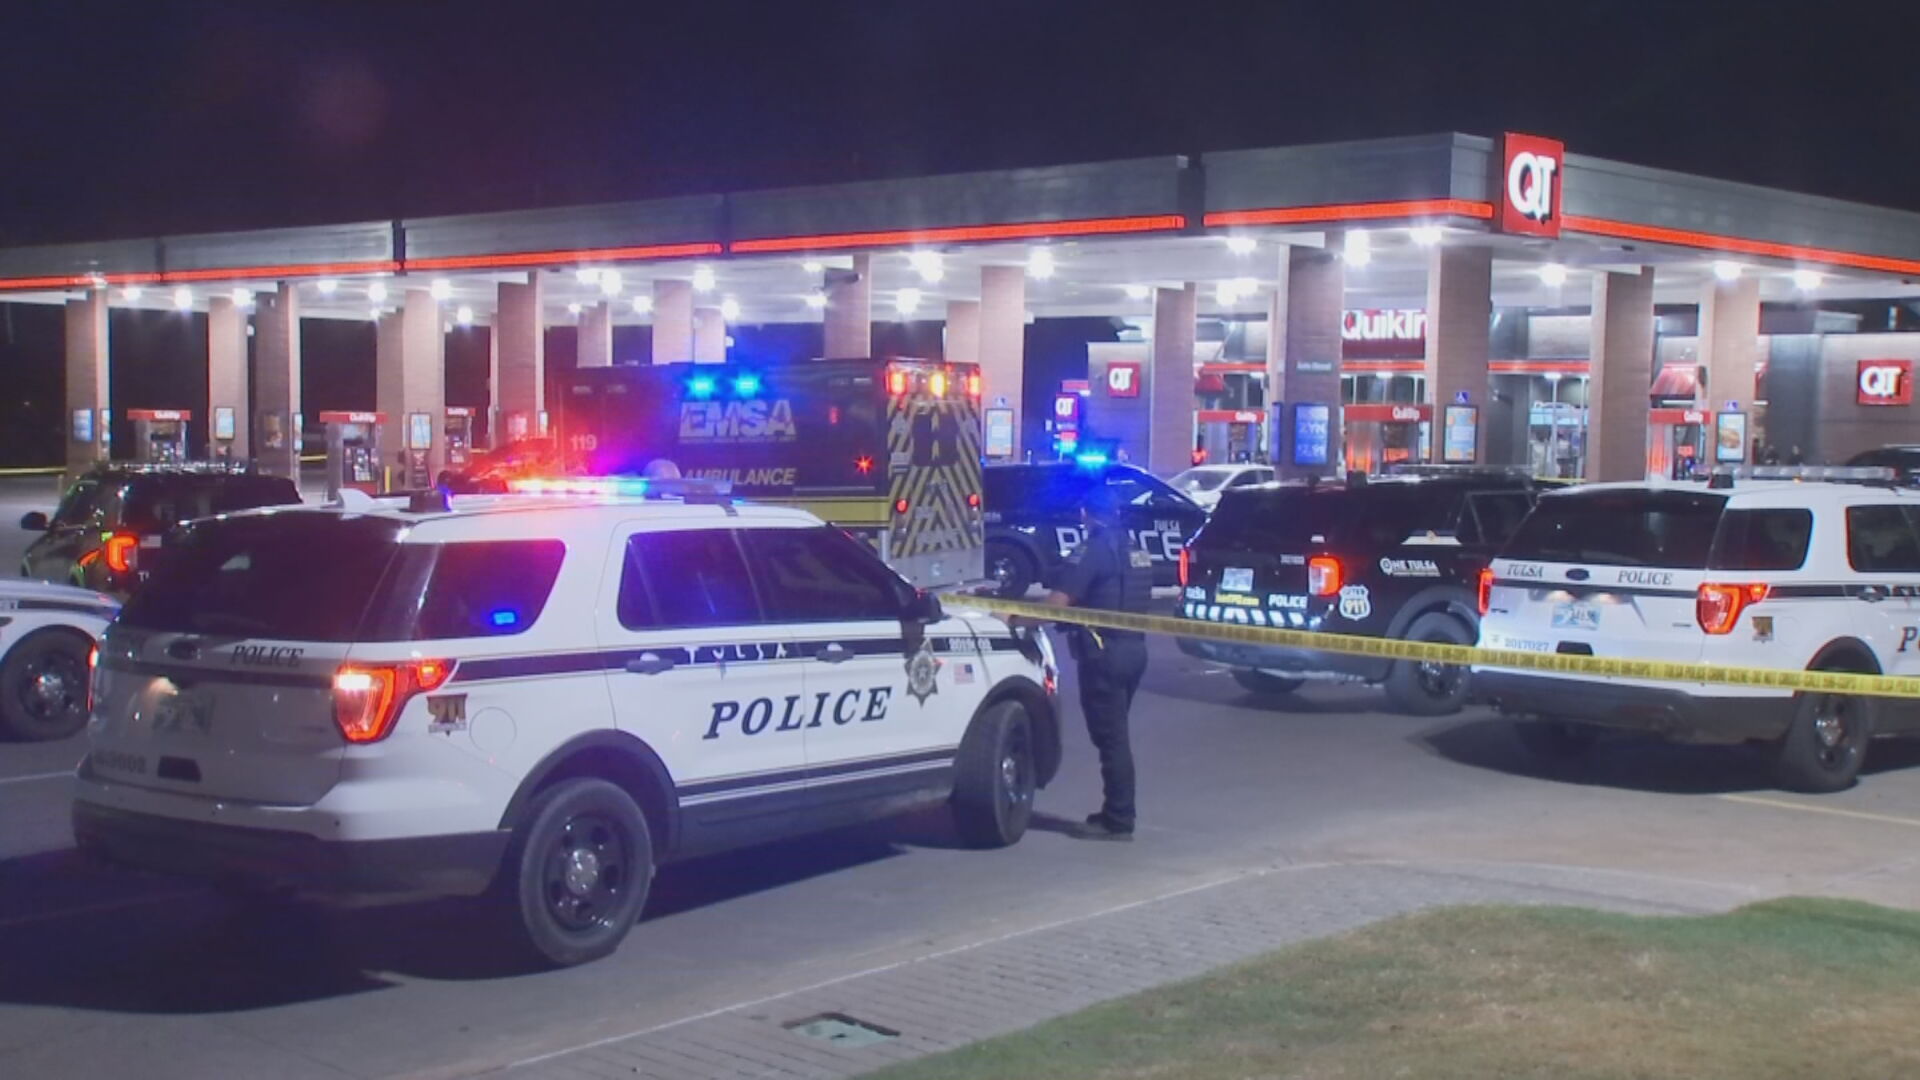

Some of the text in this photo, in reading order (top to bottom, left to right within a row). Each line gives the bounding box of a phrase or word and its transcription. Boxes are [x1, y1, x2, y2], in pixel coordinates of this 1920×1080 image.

[1508, 151, 1557, 221] QT
[1109, 367, 1133, 391] QT
[1860, 366, 1901, 398] QT
[1055, 397, 1075, 416] QT
[679, 399, 796, 437] EMSA
[570, 434, 597, 451] 119
[684, 467, 797, 485] AMBULANCE
[1153, 519, 1180, 532] TULSA
[1507, 564, 1673, 585] TULSA POLICE
[1268, 593, 1308, 609] POLICE
[1897, 626, 1920, 653] P
[231, 645, 304, 667] POLICE
[703, 686, 893, 740] POLICE
